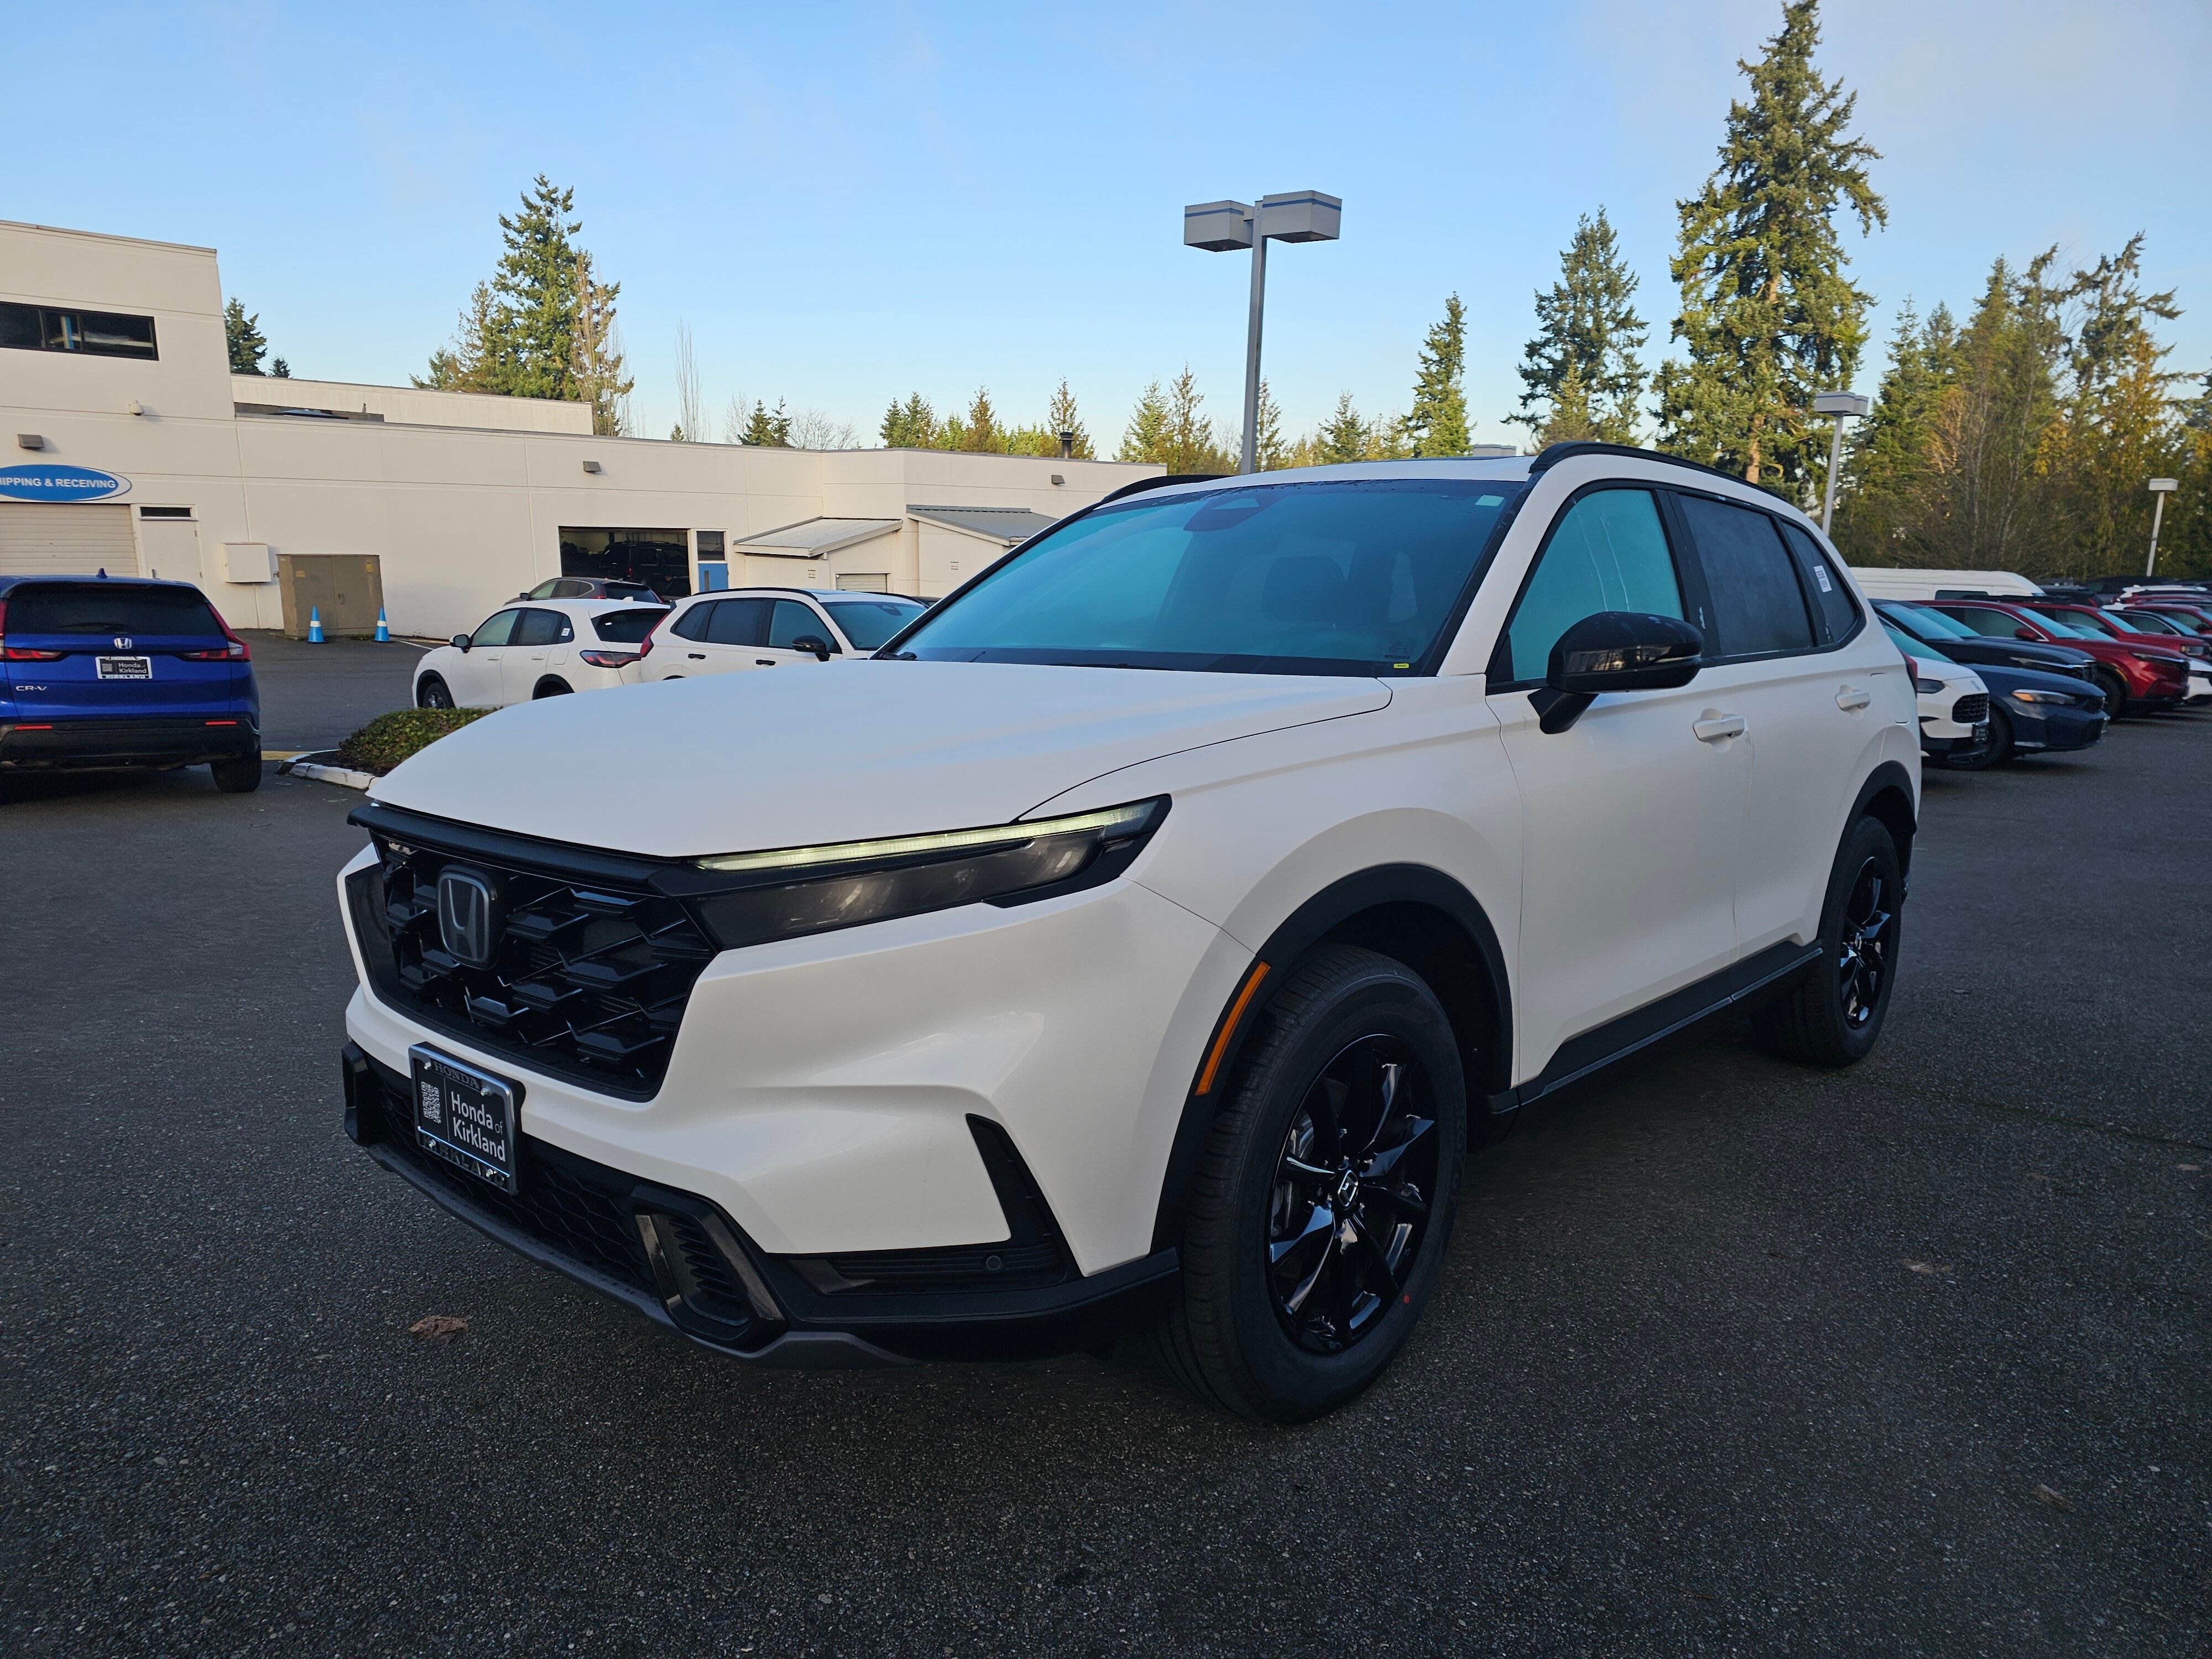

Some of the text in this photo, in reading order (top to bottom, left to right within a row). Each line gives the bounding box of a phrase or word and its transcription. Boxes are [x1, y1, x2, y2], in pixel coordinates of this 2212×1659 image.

[44, 478, 53, 487] &
[56, 478, 116, 488] RECEIVING
[433, 1060, 479, 1090] HONDA
[451, 1091, 503, 1135] Honda of
[453, 1117, 505, 1162] Kirkland
